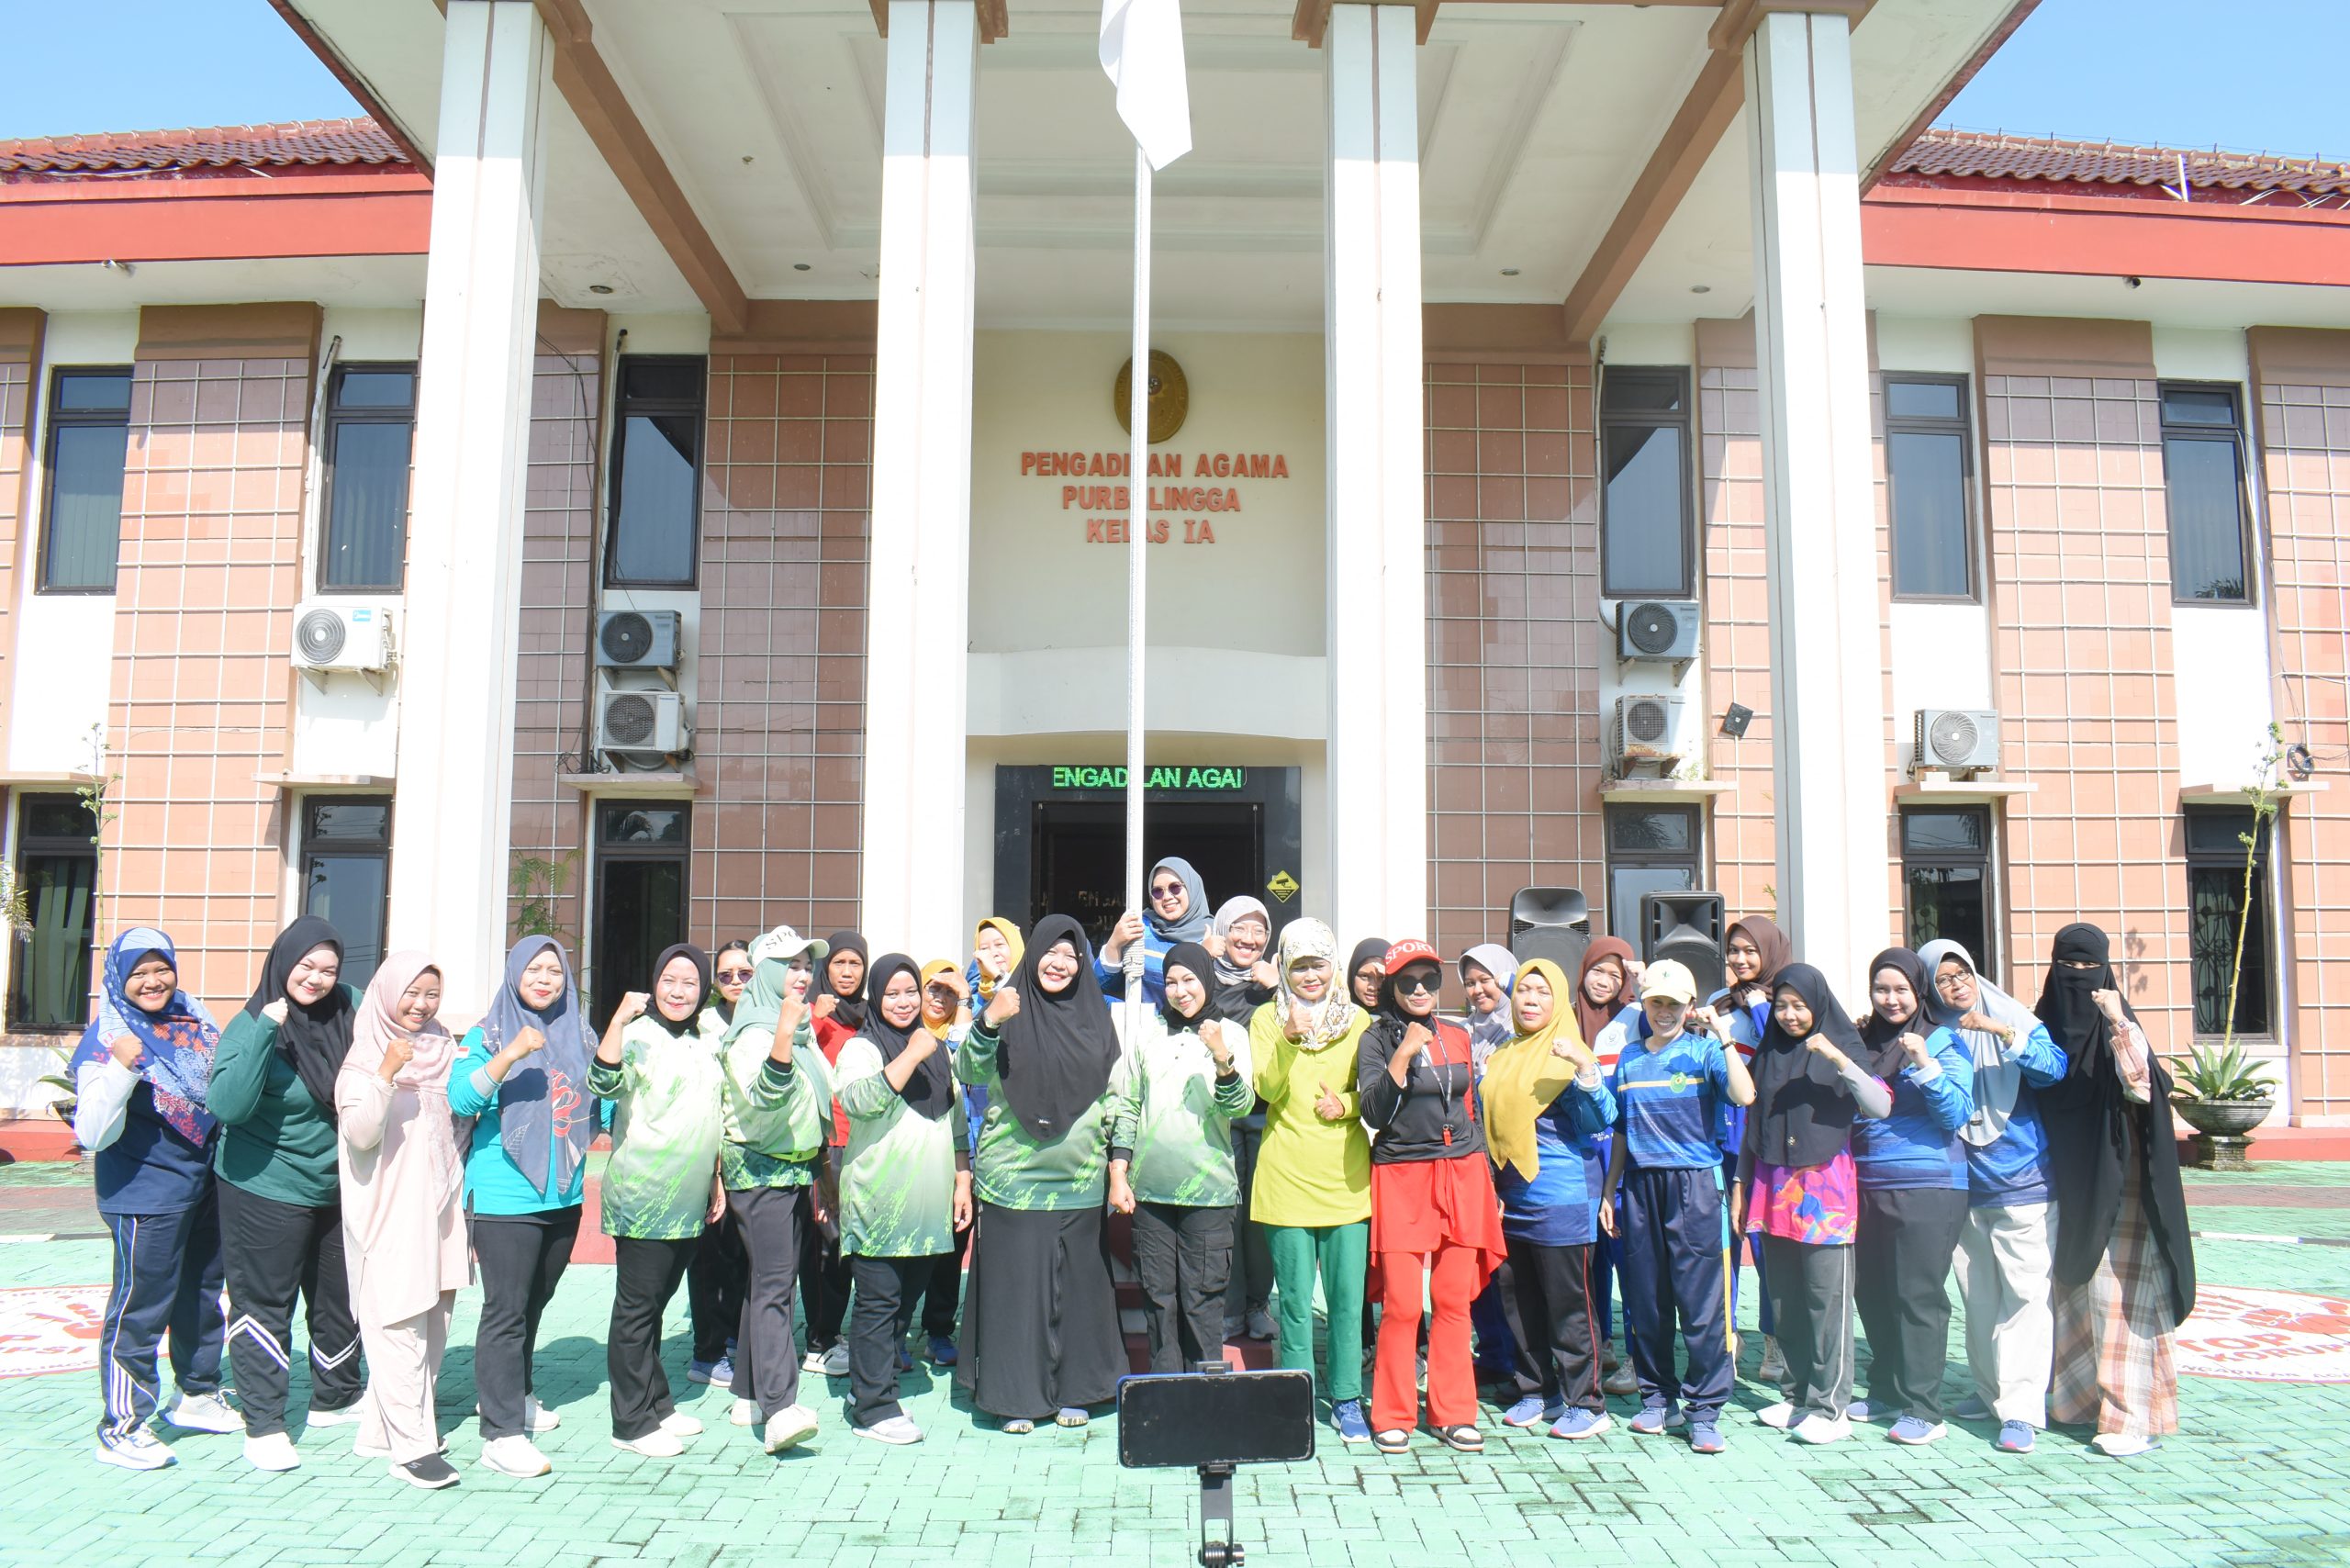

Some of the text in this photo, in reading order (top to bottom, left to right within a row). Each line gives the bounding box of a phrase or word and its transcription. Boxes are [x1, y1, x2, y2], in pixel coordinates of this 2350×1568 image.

[1021, 452, 1290, 478] PENGADIAN AGAMA
[1062, 486, 1241, 511] PURBLINGGA
[1184, 520, 1214, 543] IA
[1053, 767, 1242, 788] ENGADAN AGA
[2176, 1334, 2292, 1352] TOP
[2202, 1343, 2350, 1362] KORUP
